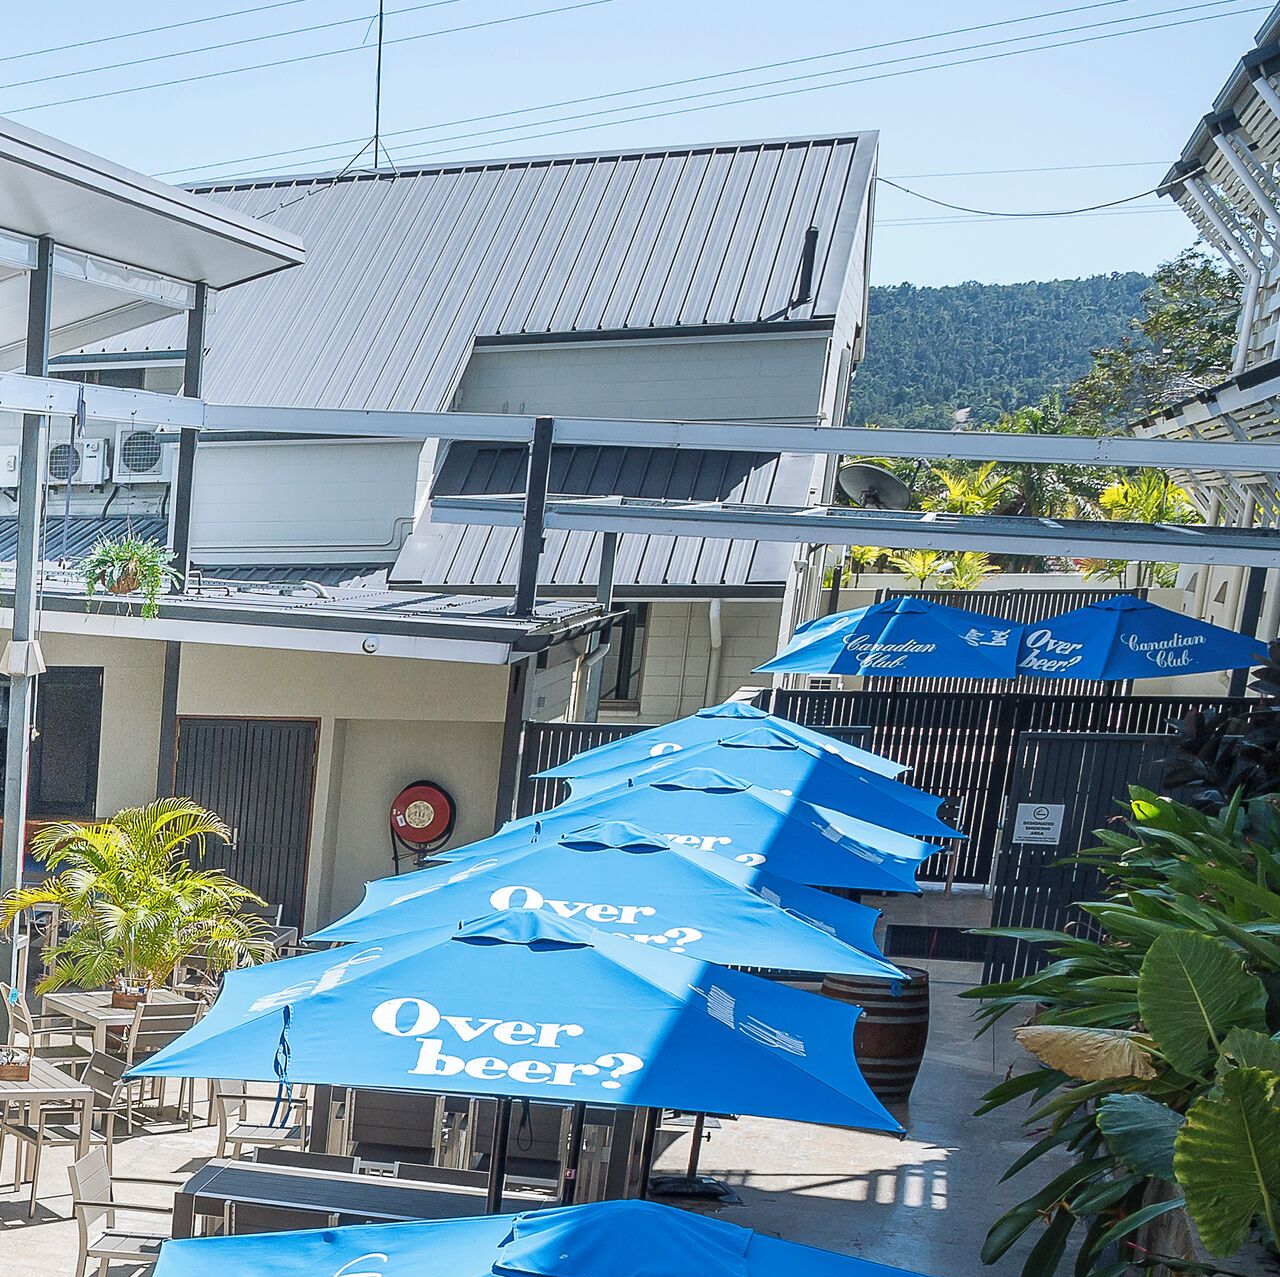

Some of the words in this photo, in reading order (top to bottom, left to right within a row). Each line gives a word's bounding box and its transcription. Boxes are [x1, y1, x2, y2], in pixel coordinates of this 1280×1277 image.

[843, 633, 936, 653] Canadian
[1026, 629, 1083, 655] Over
[1120, 632, 1207, 652] Canadian
[1018, 648, 1083, 673] beer?
[489, 885, 657, 925] Over
[371, 997, 584, 1048] Over
[407, 1037, 645, 1090] beer?
